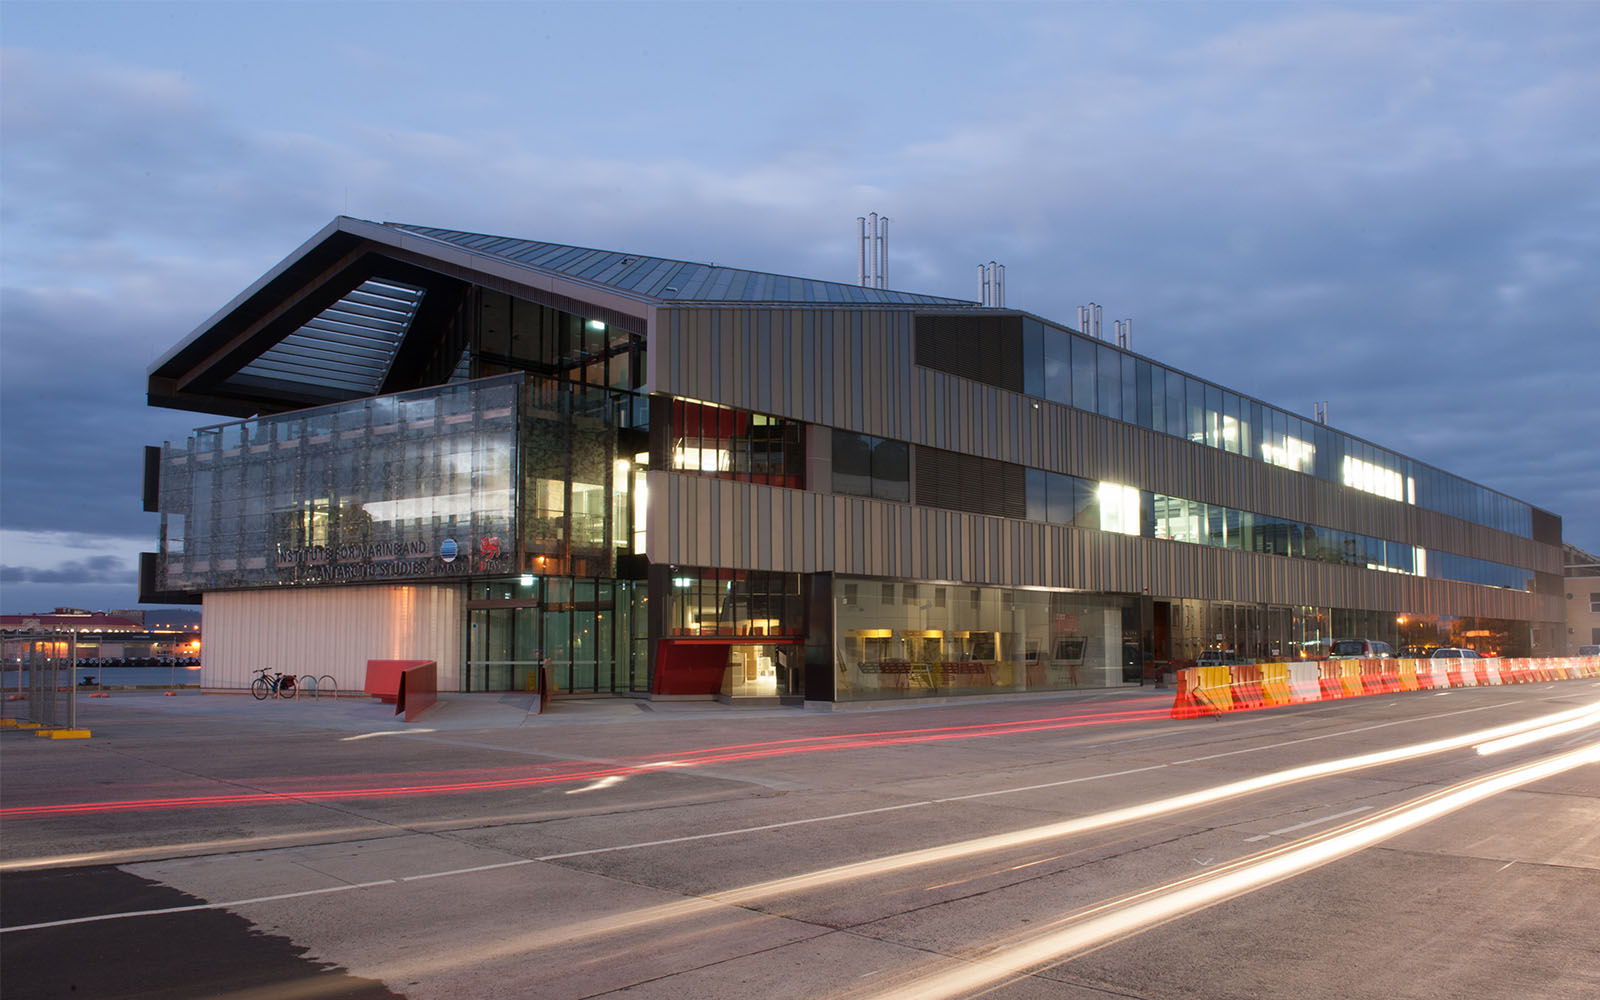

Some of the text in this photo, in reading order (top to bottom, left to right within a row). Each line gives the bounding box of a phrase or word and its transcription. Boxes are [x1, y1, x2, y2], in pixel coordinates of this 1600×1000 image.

[277, 540, 427, 563] INSTITUTE FOR MARINE AND
[319, 560, 429, 579] ANTARCTIC STUDIES
